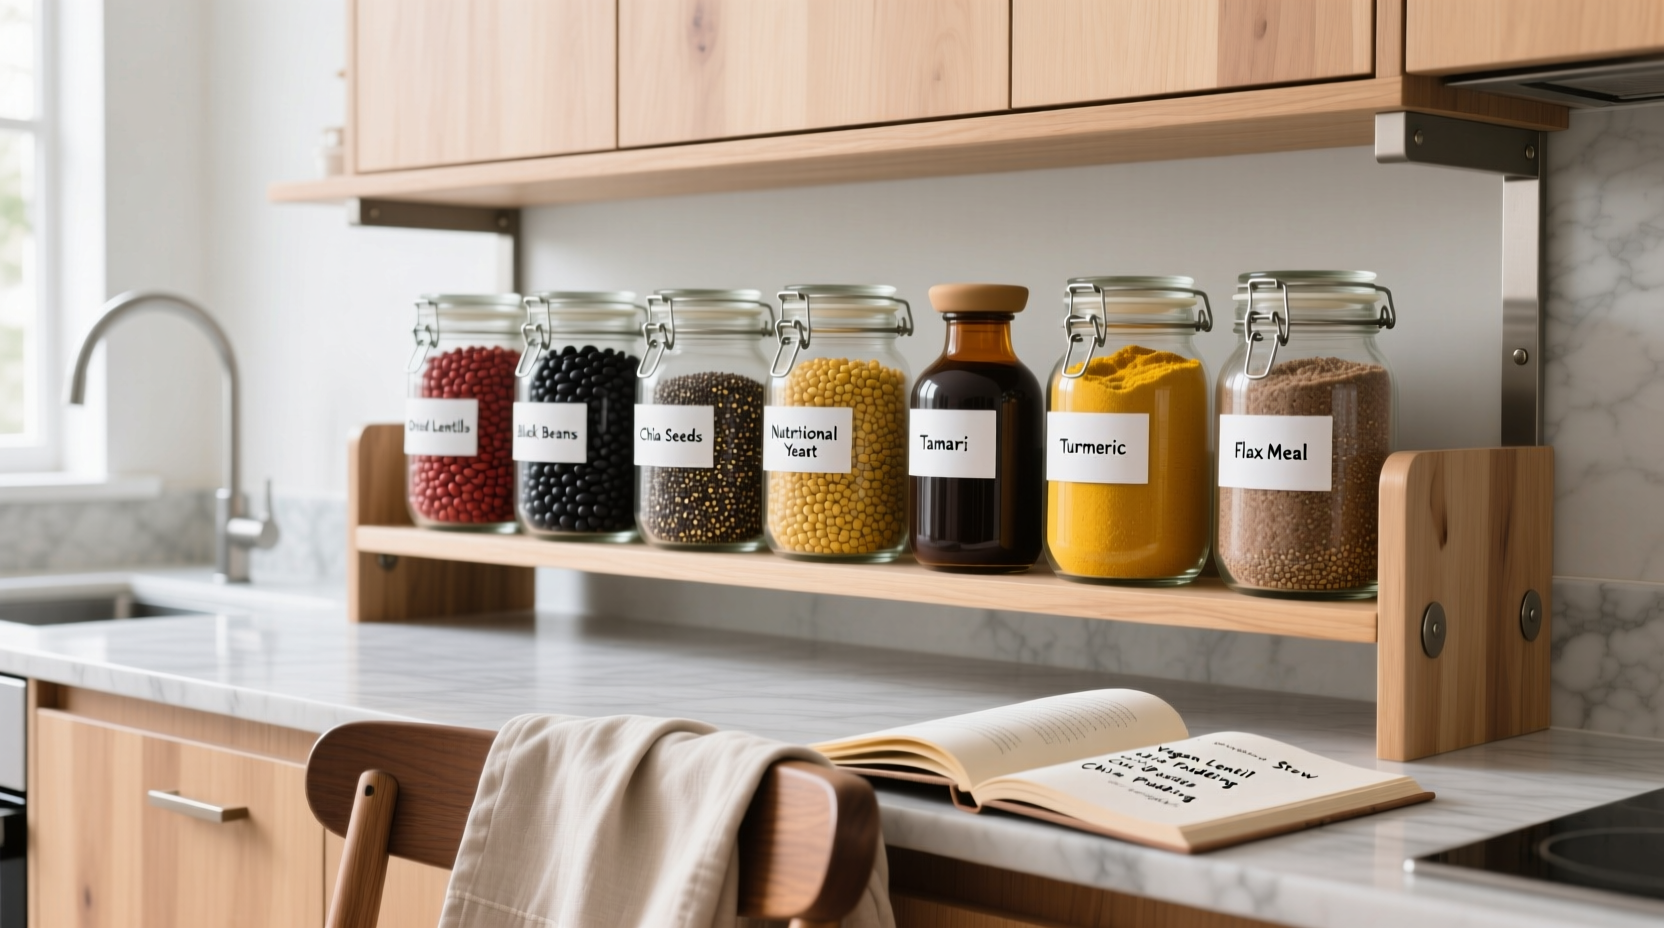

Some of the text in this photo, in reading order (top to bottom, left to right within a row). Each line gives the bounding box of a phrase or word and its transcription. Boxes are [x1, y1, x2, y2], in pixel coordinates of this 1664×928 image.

[542, 426, 578, 440] Beans
[640, 427, 703, 443] Chia Seeds
[920, 434, 968, 452] Tamari
[1060, 438, 1127, 456] Turmeric
[1235, 441, 1308, 461] Flax Meal
